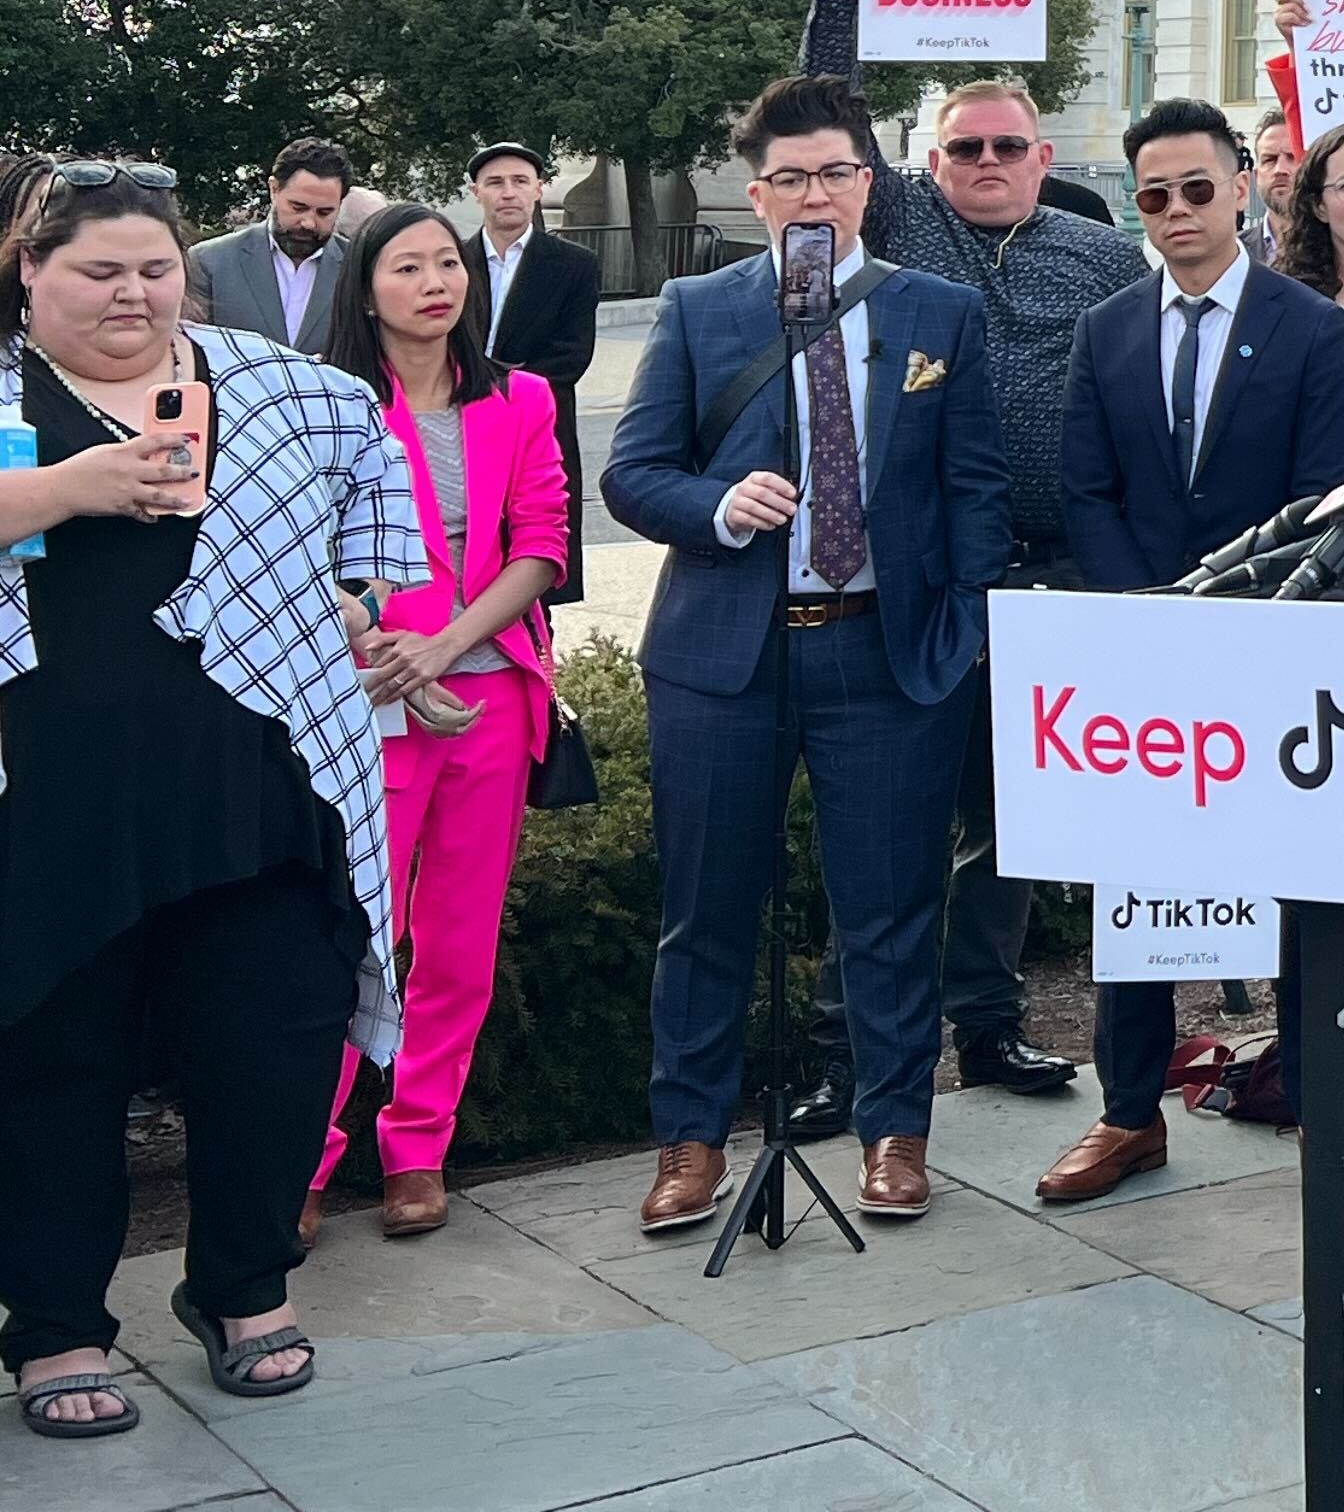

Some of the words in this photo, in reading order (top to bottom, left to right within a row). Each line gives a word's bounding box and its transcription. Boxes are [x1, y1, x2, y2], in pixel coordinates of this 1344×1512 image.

[916, 38, 990, 50] #KeepTikTok
[1031, 684, 1246, 808] Keep
[1146, 897, 1256, 928] TikTok
[1147, 952, 1220, 967] #KeepTikTok
